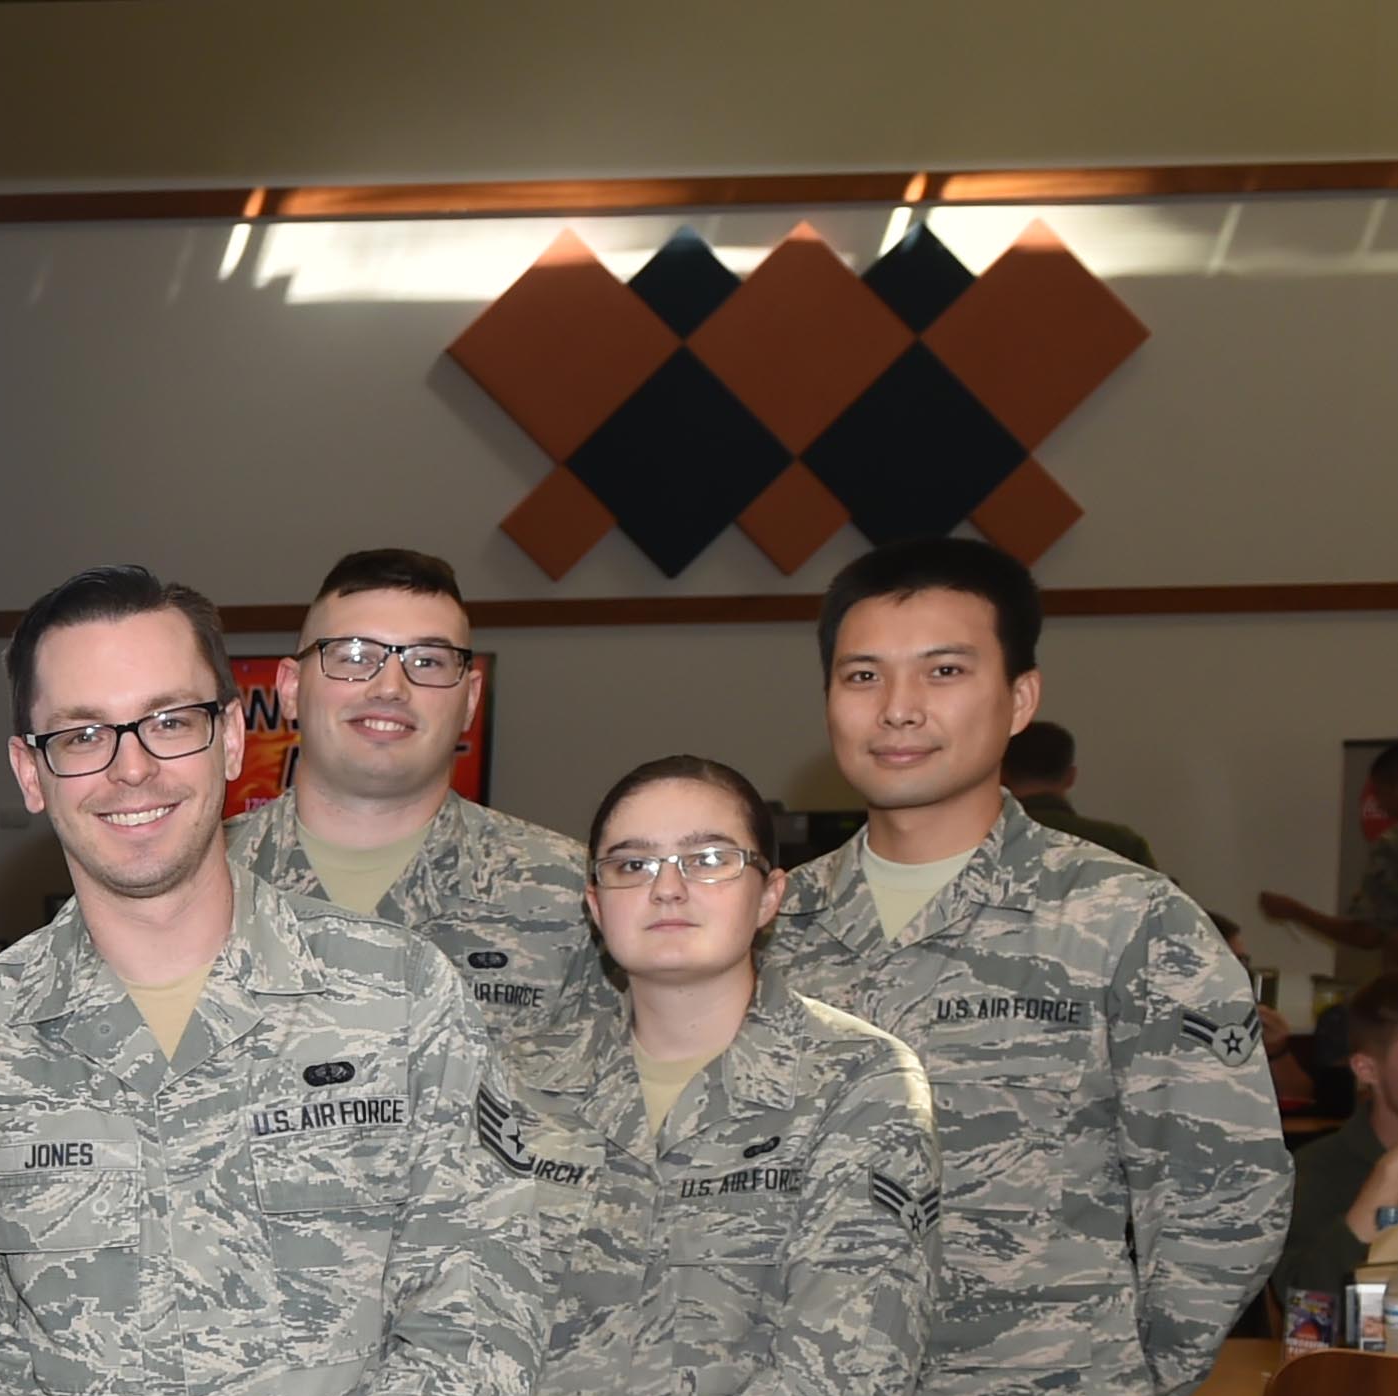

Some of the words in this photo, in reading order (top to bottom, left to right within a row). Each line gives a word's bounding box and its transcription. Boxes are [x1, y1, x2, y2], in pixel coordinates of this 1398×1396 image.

[468, 982, 491, 1002] IR
[977, 998, 1010, 1020] AIR
[1013, 998, 1082, 1024] FORCE
[253, 1110, 295, 1136] U.S.
[301, 1102, 337, 1130] AIR
[339, 1099, 405, 1126] FORCE
[24, 1142, 94, 1169] JONES
[680, 1178, 714, 1199] U.S.
[718, 1170, 749, 1195] AIR
